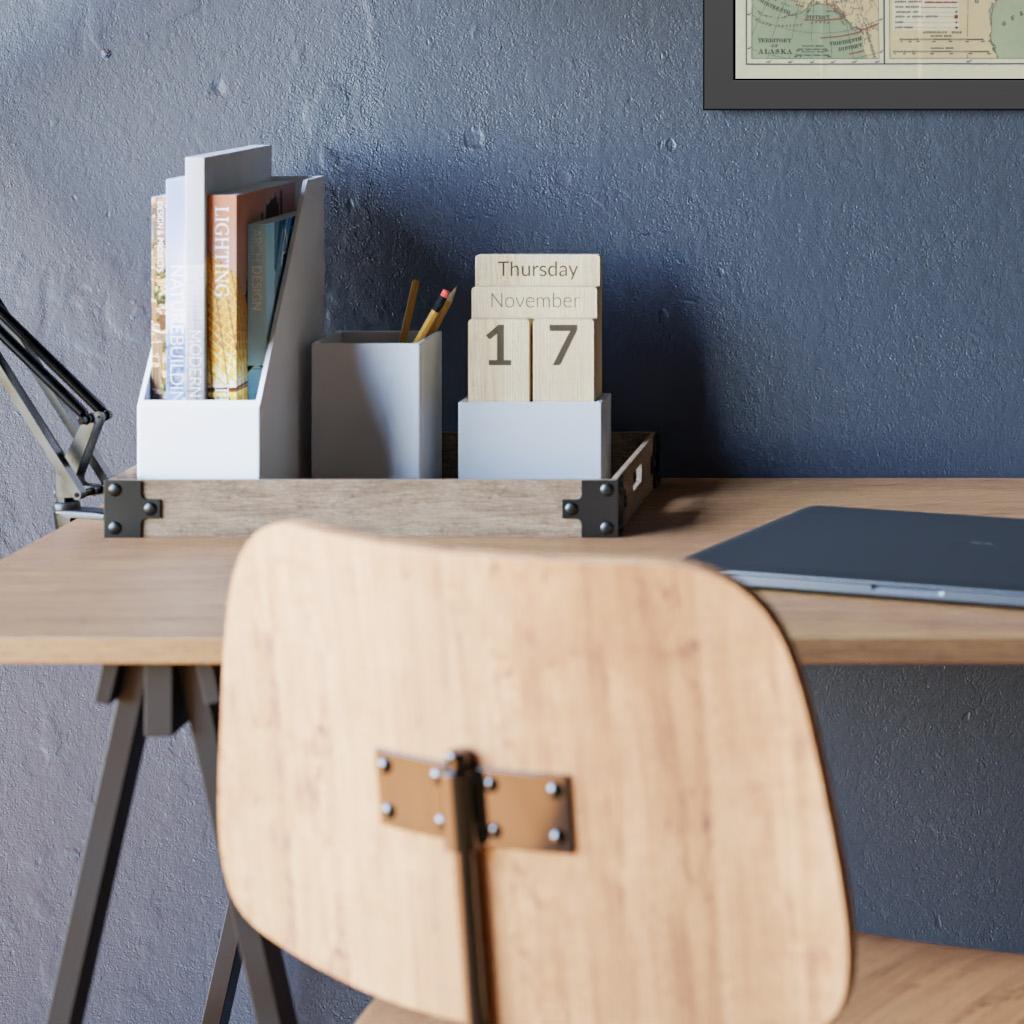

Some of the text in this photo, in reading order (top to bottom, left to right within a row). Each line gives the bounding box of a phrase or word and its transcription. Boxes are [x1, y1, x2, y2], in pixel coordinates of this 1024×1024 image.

[214, 207, 230, 299] LIGHTING
[498, 261, 579, 280] Thursday
[490, 292, 580, 309] November
[189, 329, 201, 399] MODERN
[486, 324, 578, 366] 1 7
